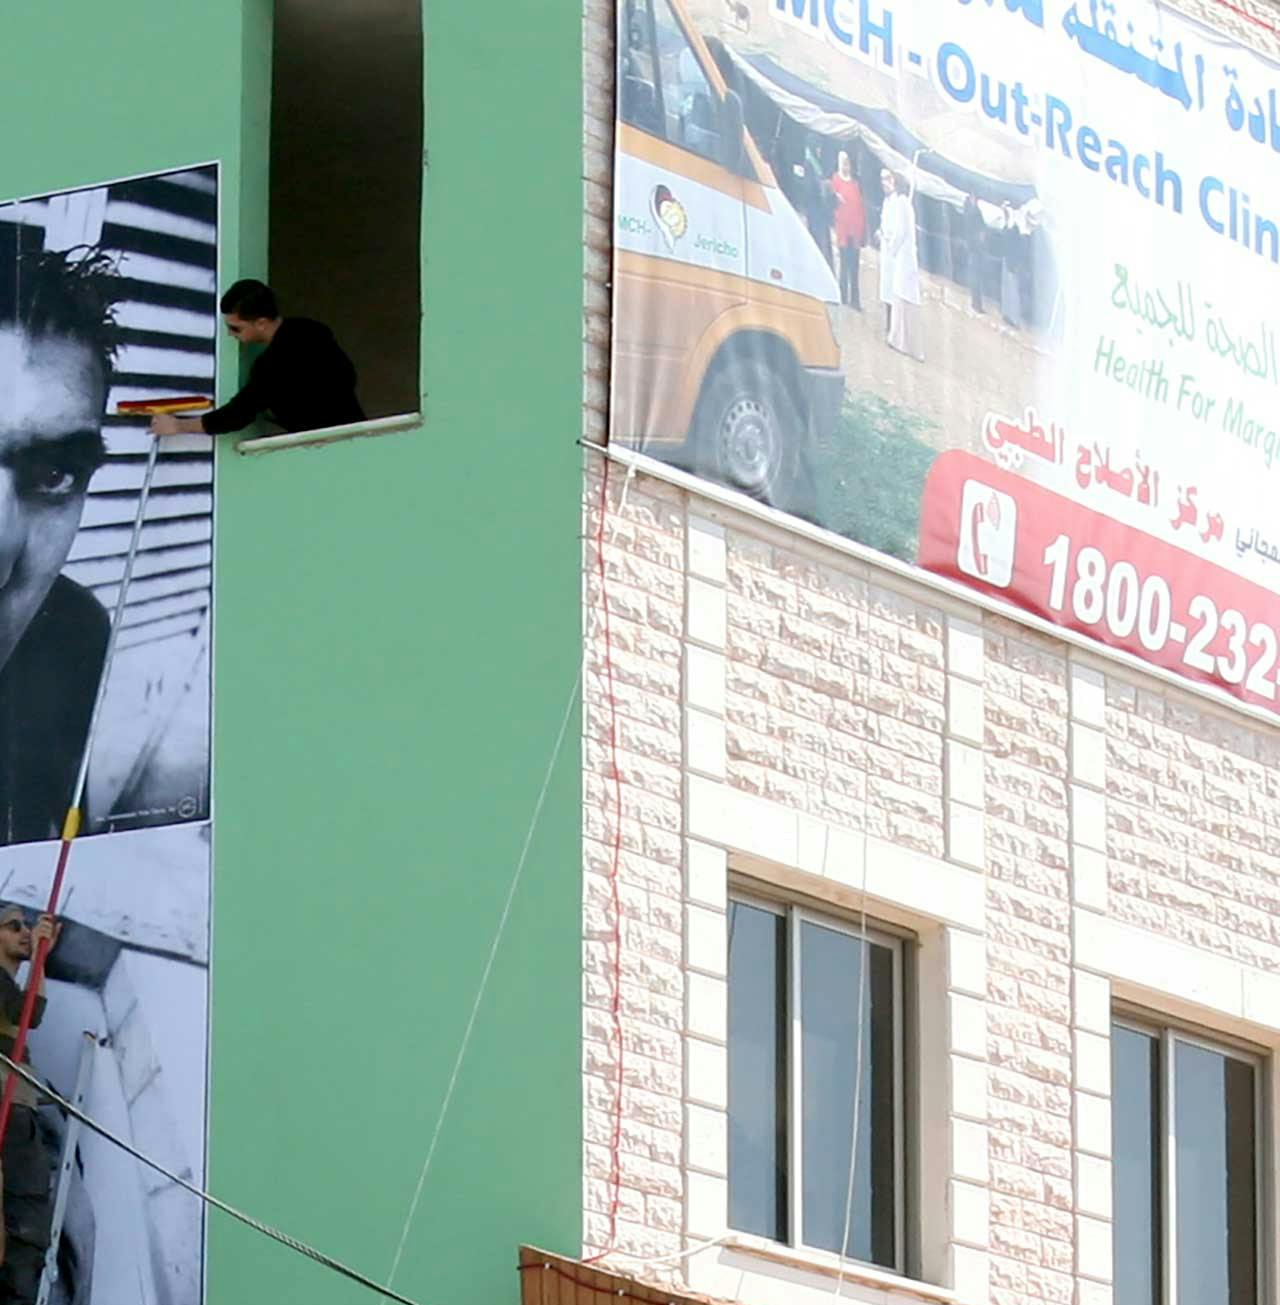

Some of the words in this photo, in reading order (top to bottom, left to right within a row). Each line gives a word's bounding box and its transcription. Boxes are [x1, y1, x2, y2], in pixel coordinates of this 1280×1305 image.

[937, 42, 1183, 215] Out-Reach
[1094, 335, 1169, 403] Health
[1177, 374, 1216, 423] For
